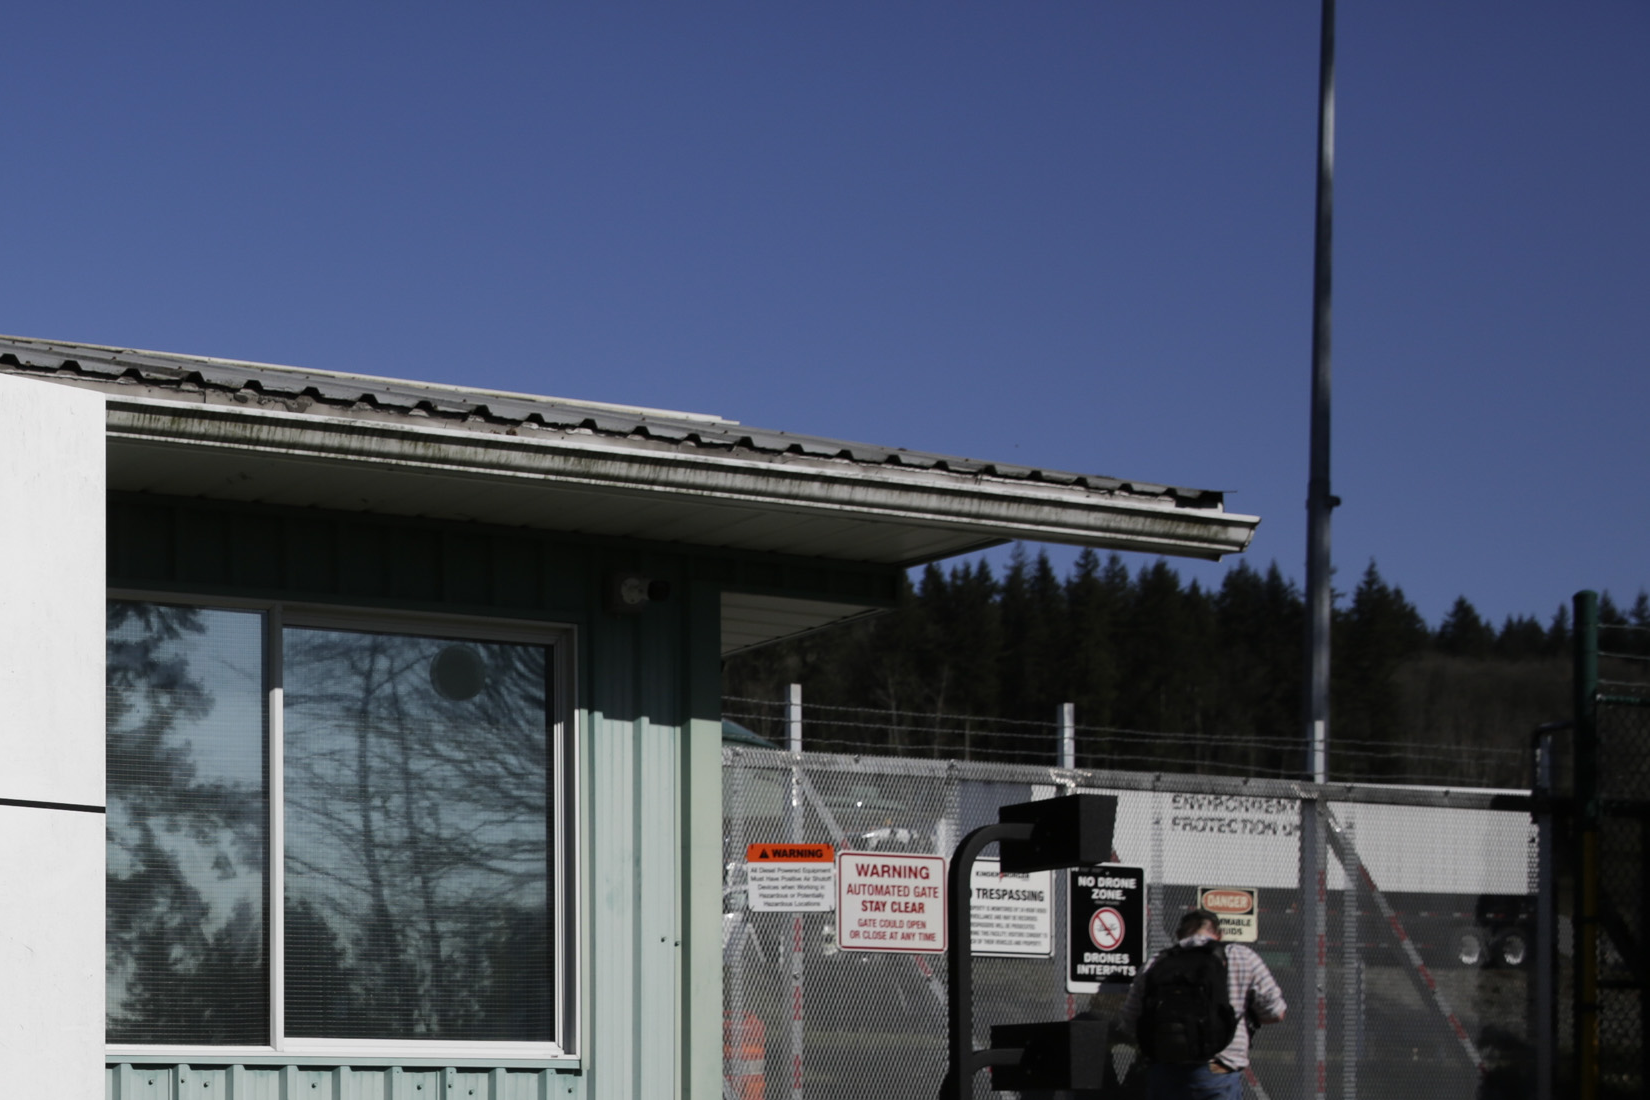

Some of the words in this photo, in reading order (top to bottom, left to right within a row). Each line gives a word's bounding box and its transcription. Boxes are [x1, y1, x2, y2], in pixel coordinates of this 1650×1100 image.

[772, 848, 824, 859] WARNING
[855, 863, 930, 880] WARNING
[1078, 876, 1096, 887] NO
[1097, 876, 1137, 889] DRONE
[847, 883, 910, 897] AUTOMATED
[913, 886, 939, 898] GATE
[976, 888, 1045, 902] TRESPASSING
[1091, 888, 1126, 900] ZONE.
[861, 900, 887, 912] STAY
[891, 901, 925, 913] CLEAR
[1207, 894, 1248, 908] DANGER
[857, 918, 877, 928] GATE
[879, 919, 904, 929] COULD
[906, 920, 926, 929] OPEN
[849, 930, 860, 939] OR
[862, 931, 887, 940] CLOSE
[889, 932, 898, 940] AT
[901, 932, 916, 941] ANY
[918, 932, 937, 942] TIME
[1083, 952, 1130, 964] DRONES
